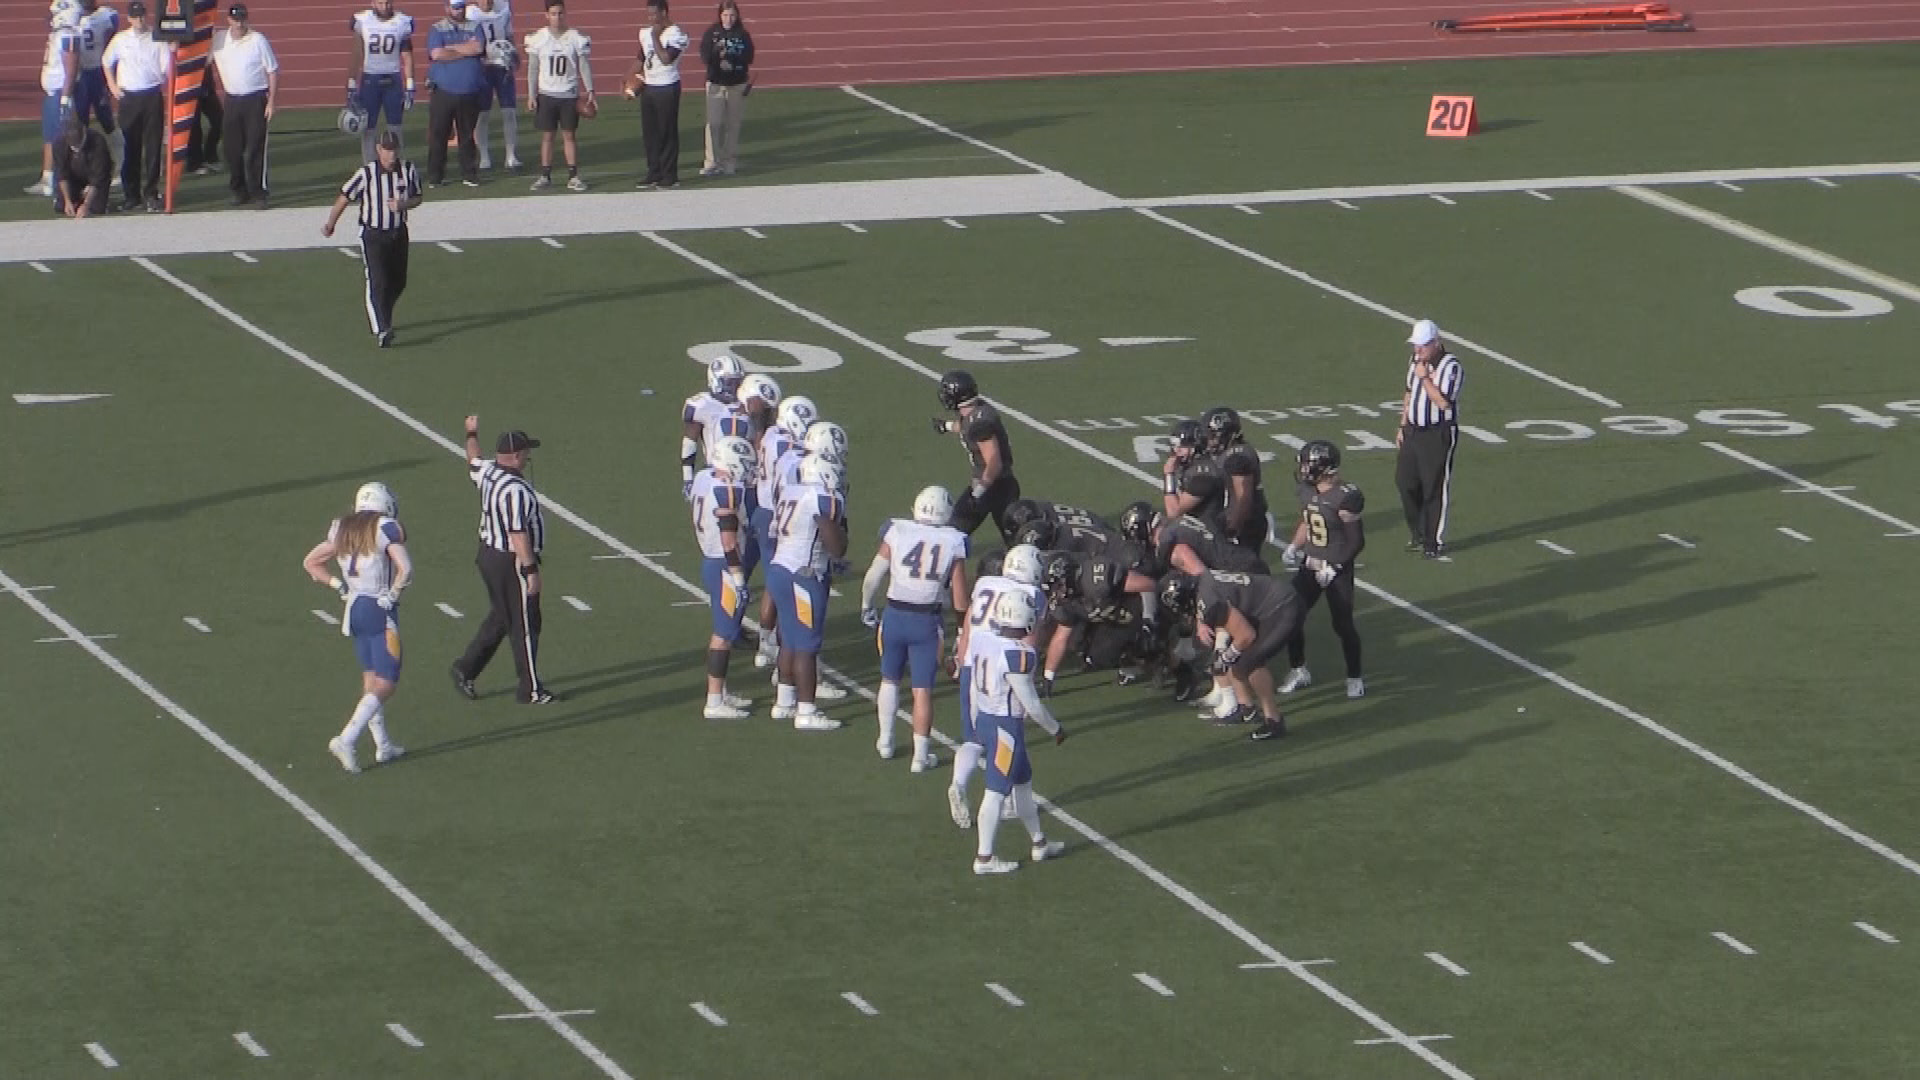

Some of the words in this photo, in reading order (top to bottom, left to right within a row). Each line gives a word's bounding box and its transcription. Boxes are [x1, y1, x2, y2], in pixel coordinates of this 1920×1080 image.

[369, 34, 396, 54] 20
[549, 55, 567, 77] 10
[1430, 99, 1469, 131] 20
[901, 541, 942, 580] 41
